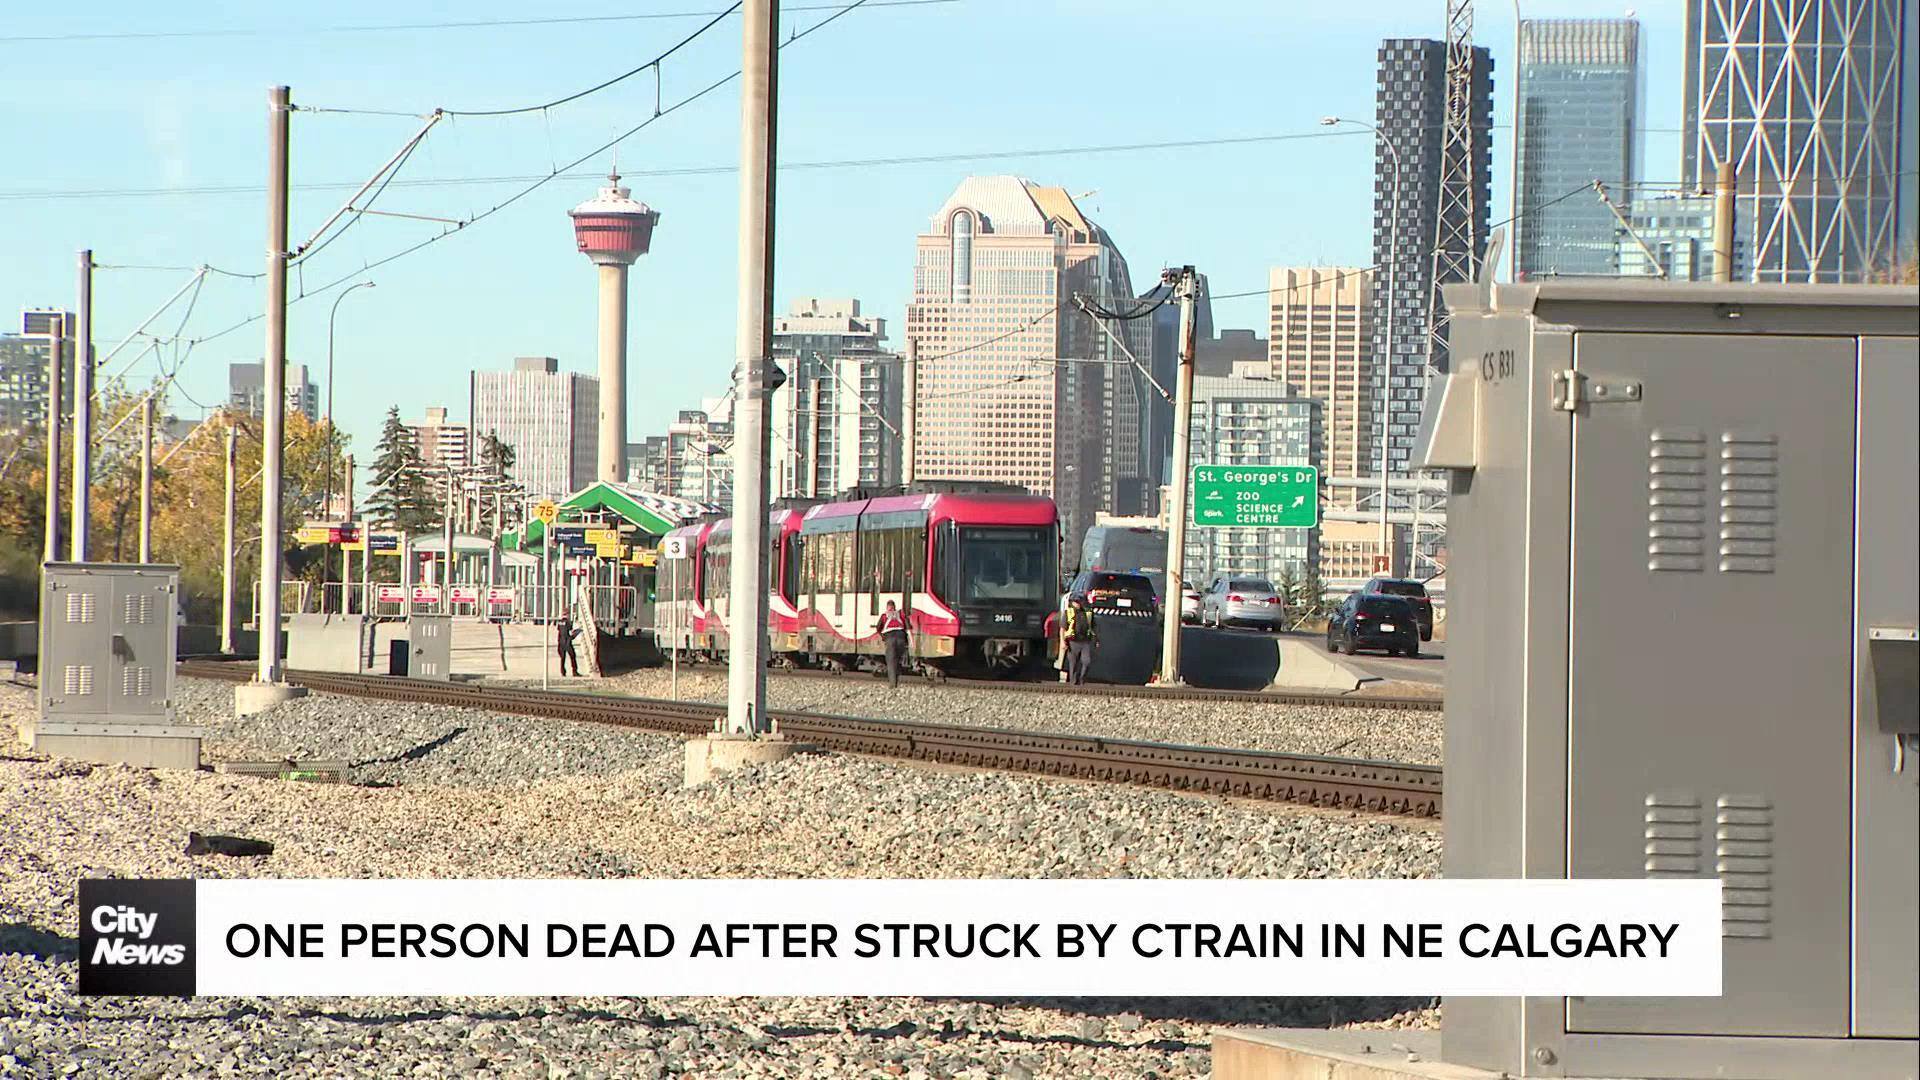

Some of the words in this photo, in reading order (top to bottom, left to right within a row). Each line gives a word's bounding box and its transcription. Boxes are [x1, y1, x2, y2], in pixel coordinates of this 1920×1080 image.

[1198, 471, 1217, 482] St.
[1224, 471, 1289, 486] George's
[1295, 472, 1312, 483] Dr
[1236, 491, 1260, 501] ZOO
[539, 505, 554, 517] 75
[1236, 503, 1283, 513] SCIENCE
[1236, 514, 1279, 524] CENTRE
[671, 541, 680, 554] 3
